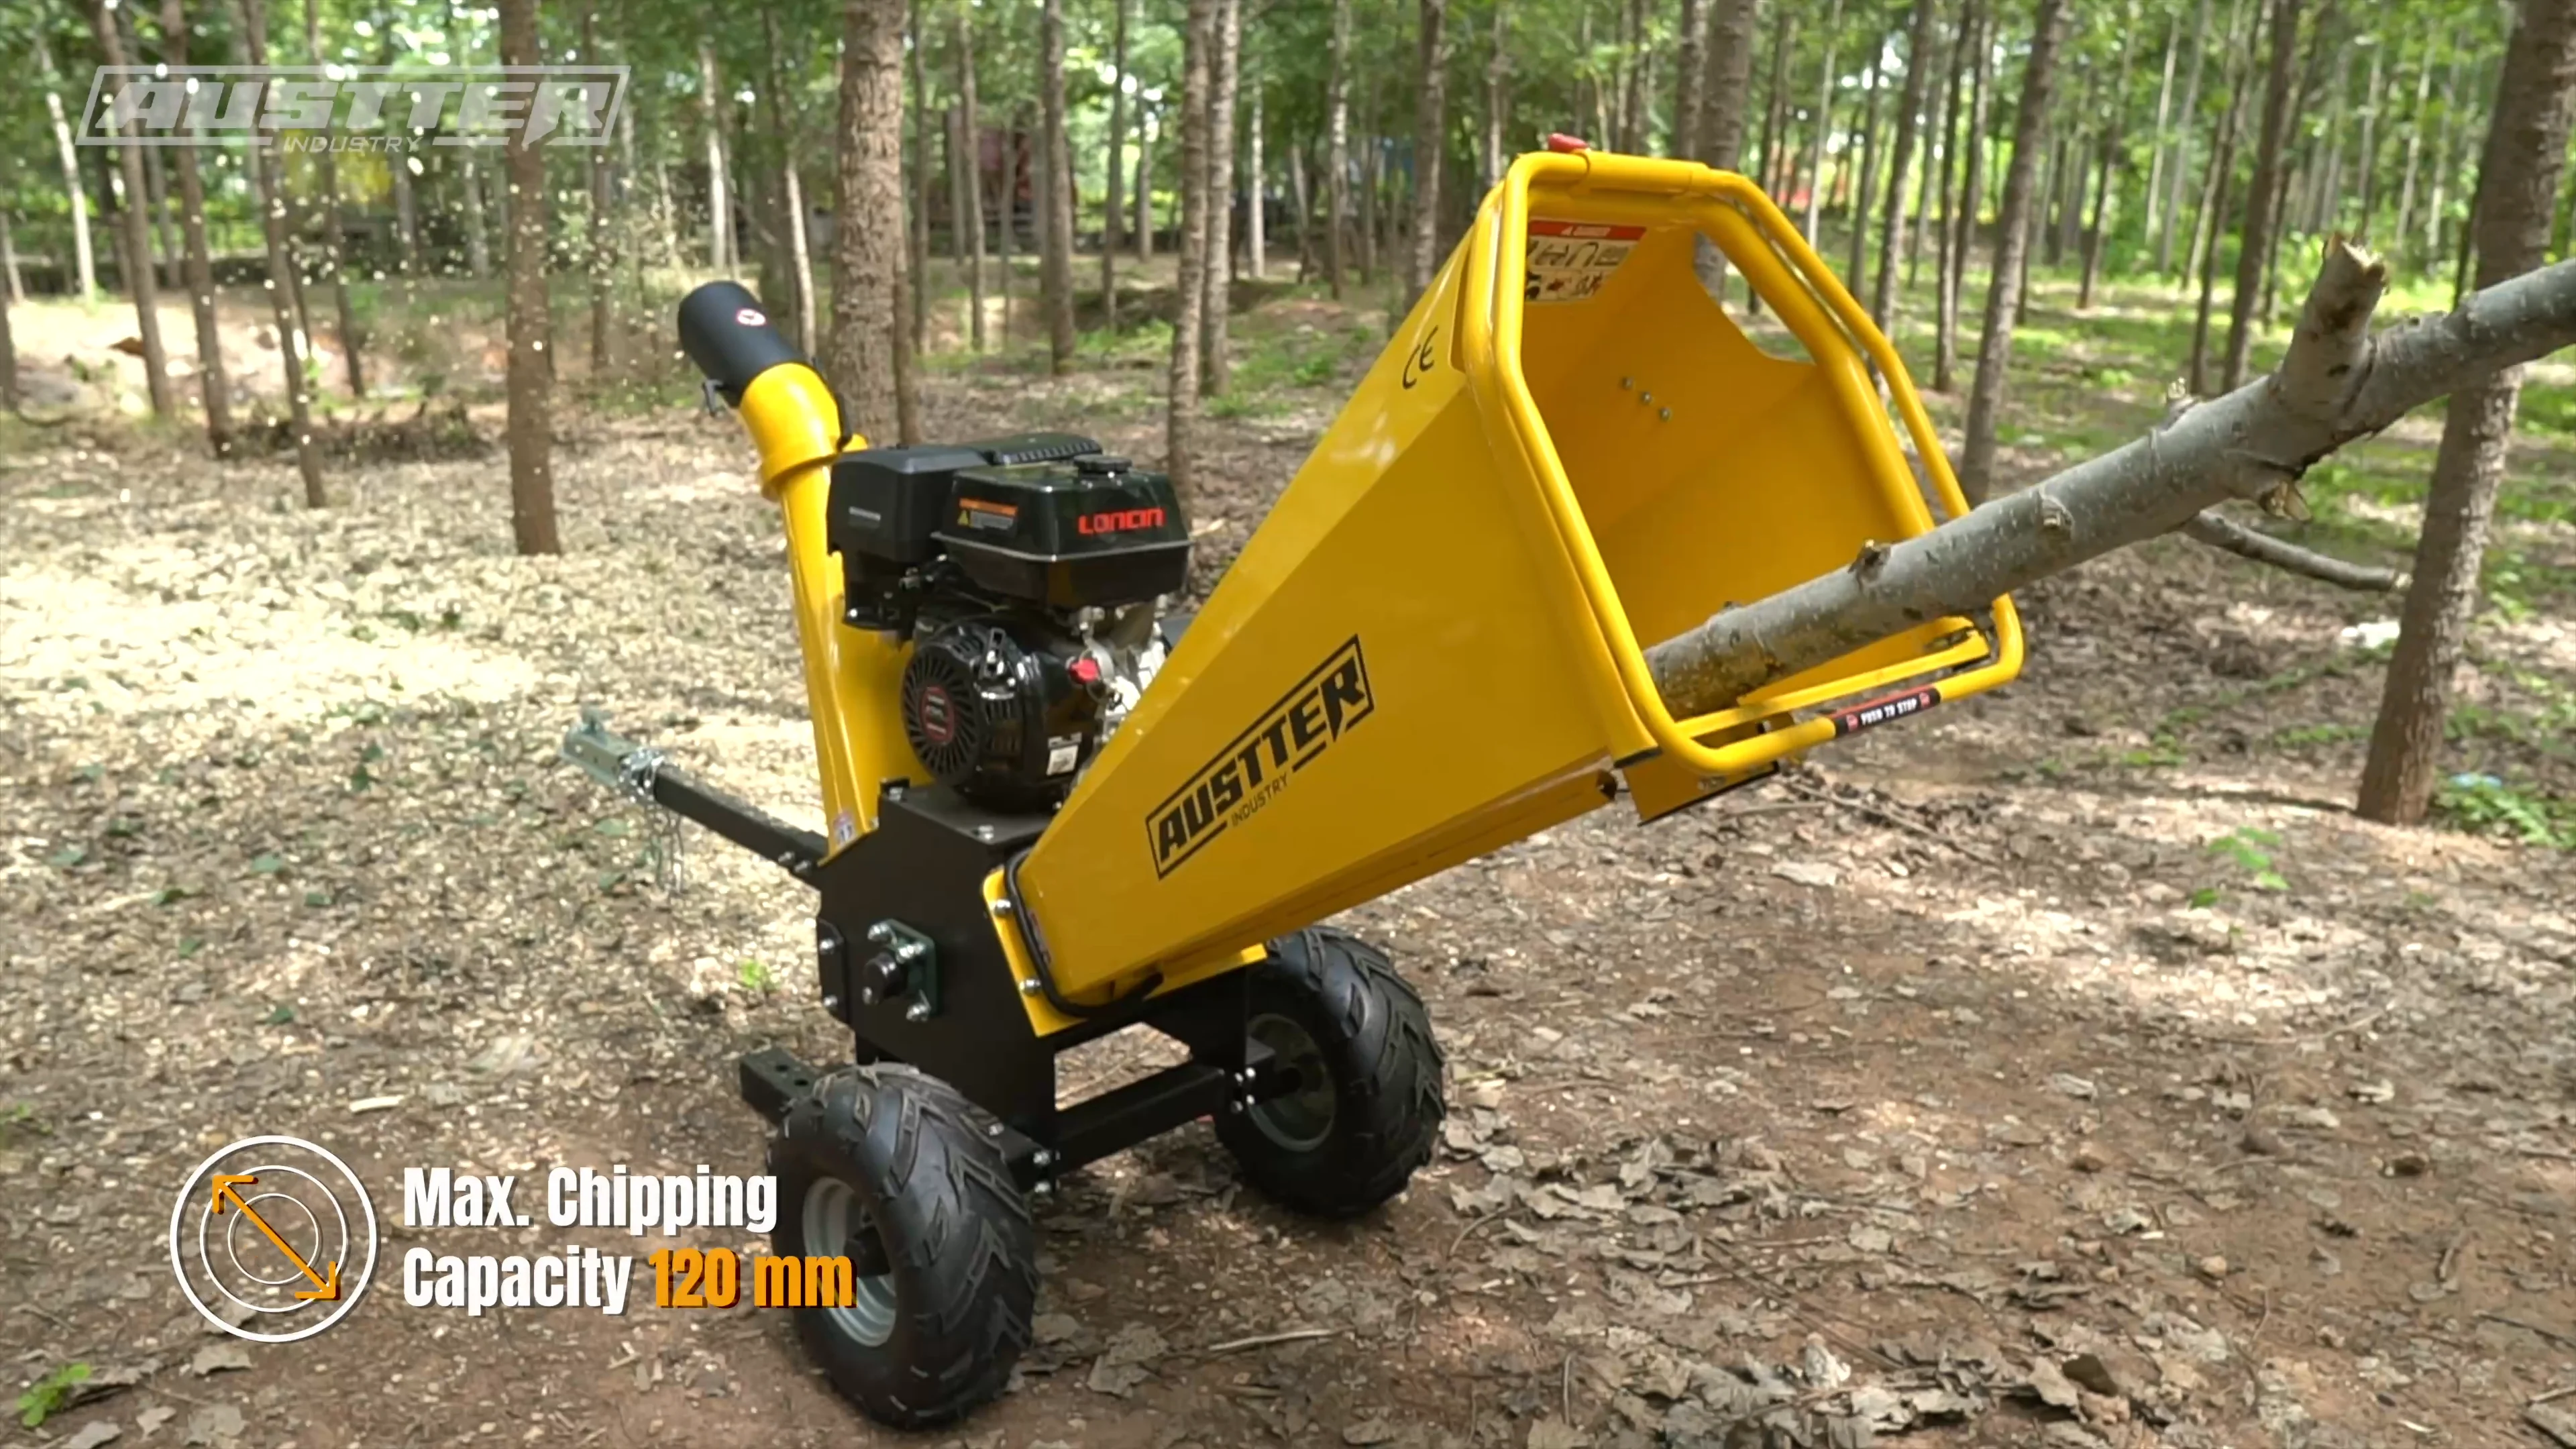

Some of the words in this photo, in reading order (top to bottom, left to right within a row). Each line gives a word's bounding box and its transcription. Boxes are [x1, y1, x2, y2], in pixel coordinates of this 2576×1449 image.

[1402, 325, 1438, 390] CE
[1896, 698, 1917, 714] STOP
[1158, 655, 1365, 863] AUSTTER
[1230, 772, 1289, 828] INDUSTRY
